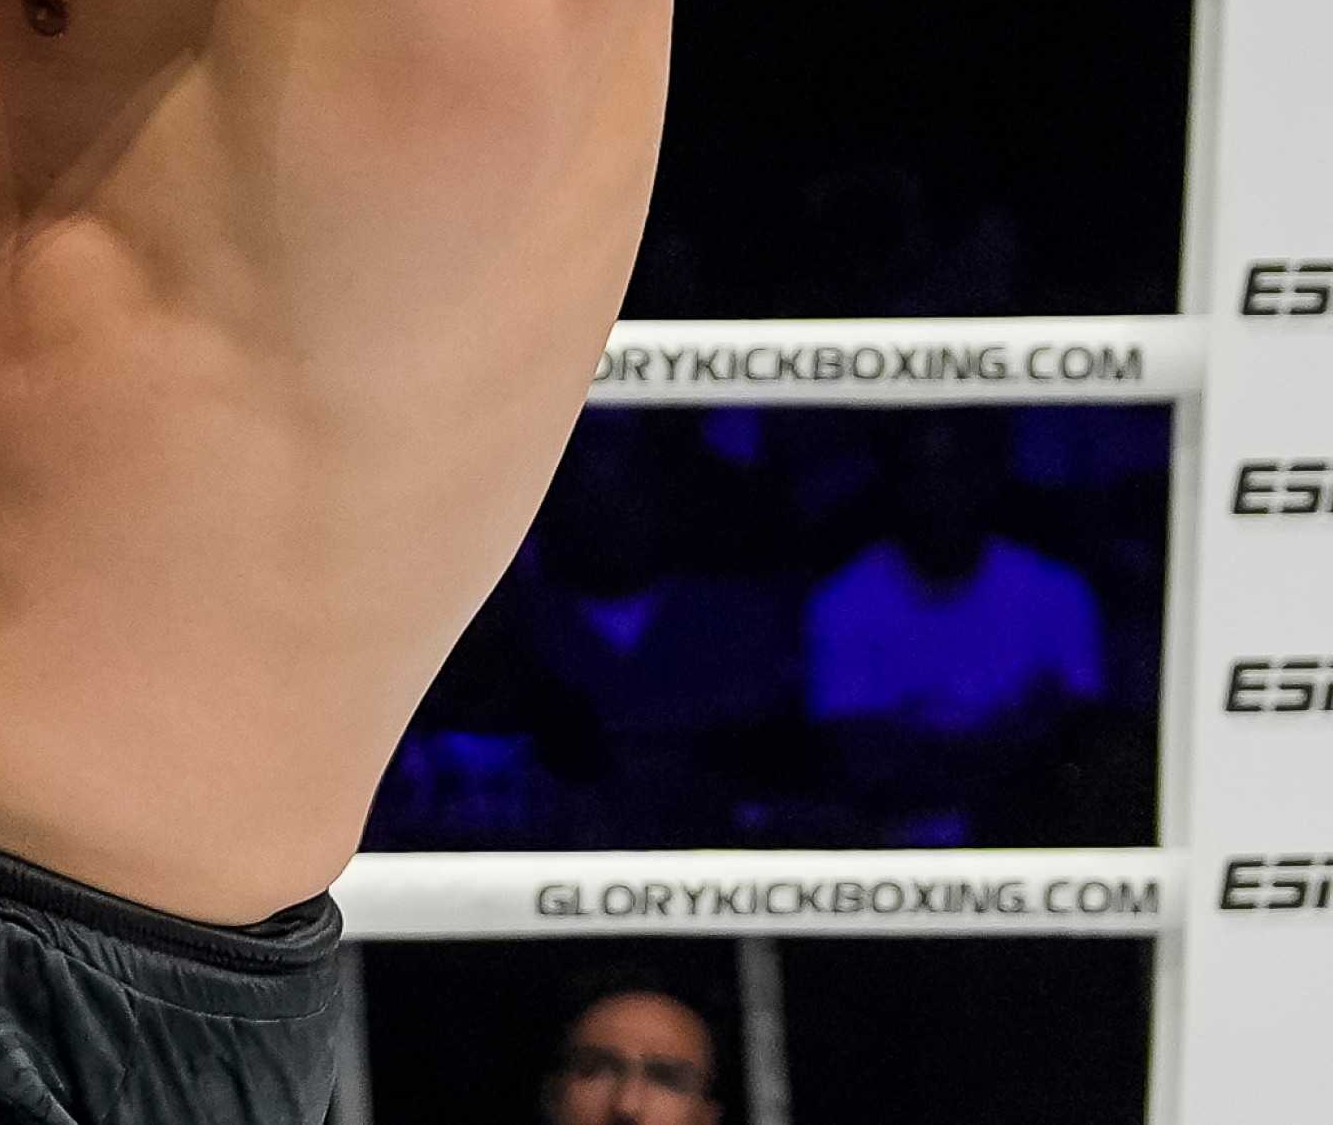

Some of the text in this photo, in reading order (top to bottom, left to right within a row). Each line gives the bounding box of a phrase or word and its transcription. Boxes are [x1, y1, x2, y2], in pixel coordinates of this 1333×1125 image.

[1241, 263, 1333, 315] ES
[1232, 464, 1333, 514] ES
[1225, 661, 1333, 712] ES
